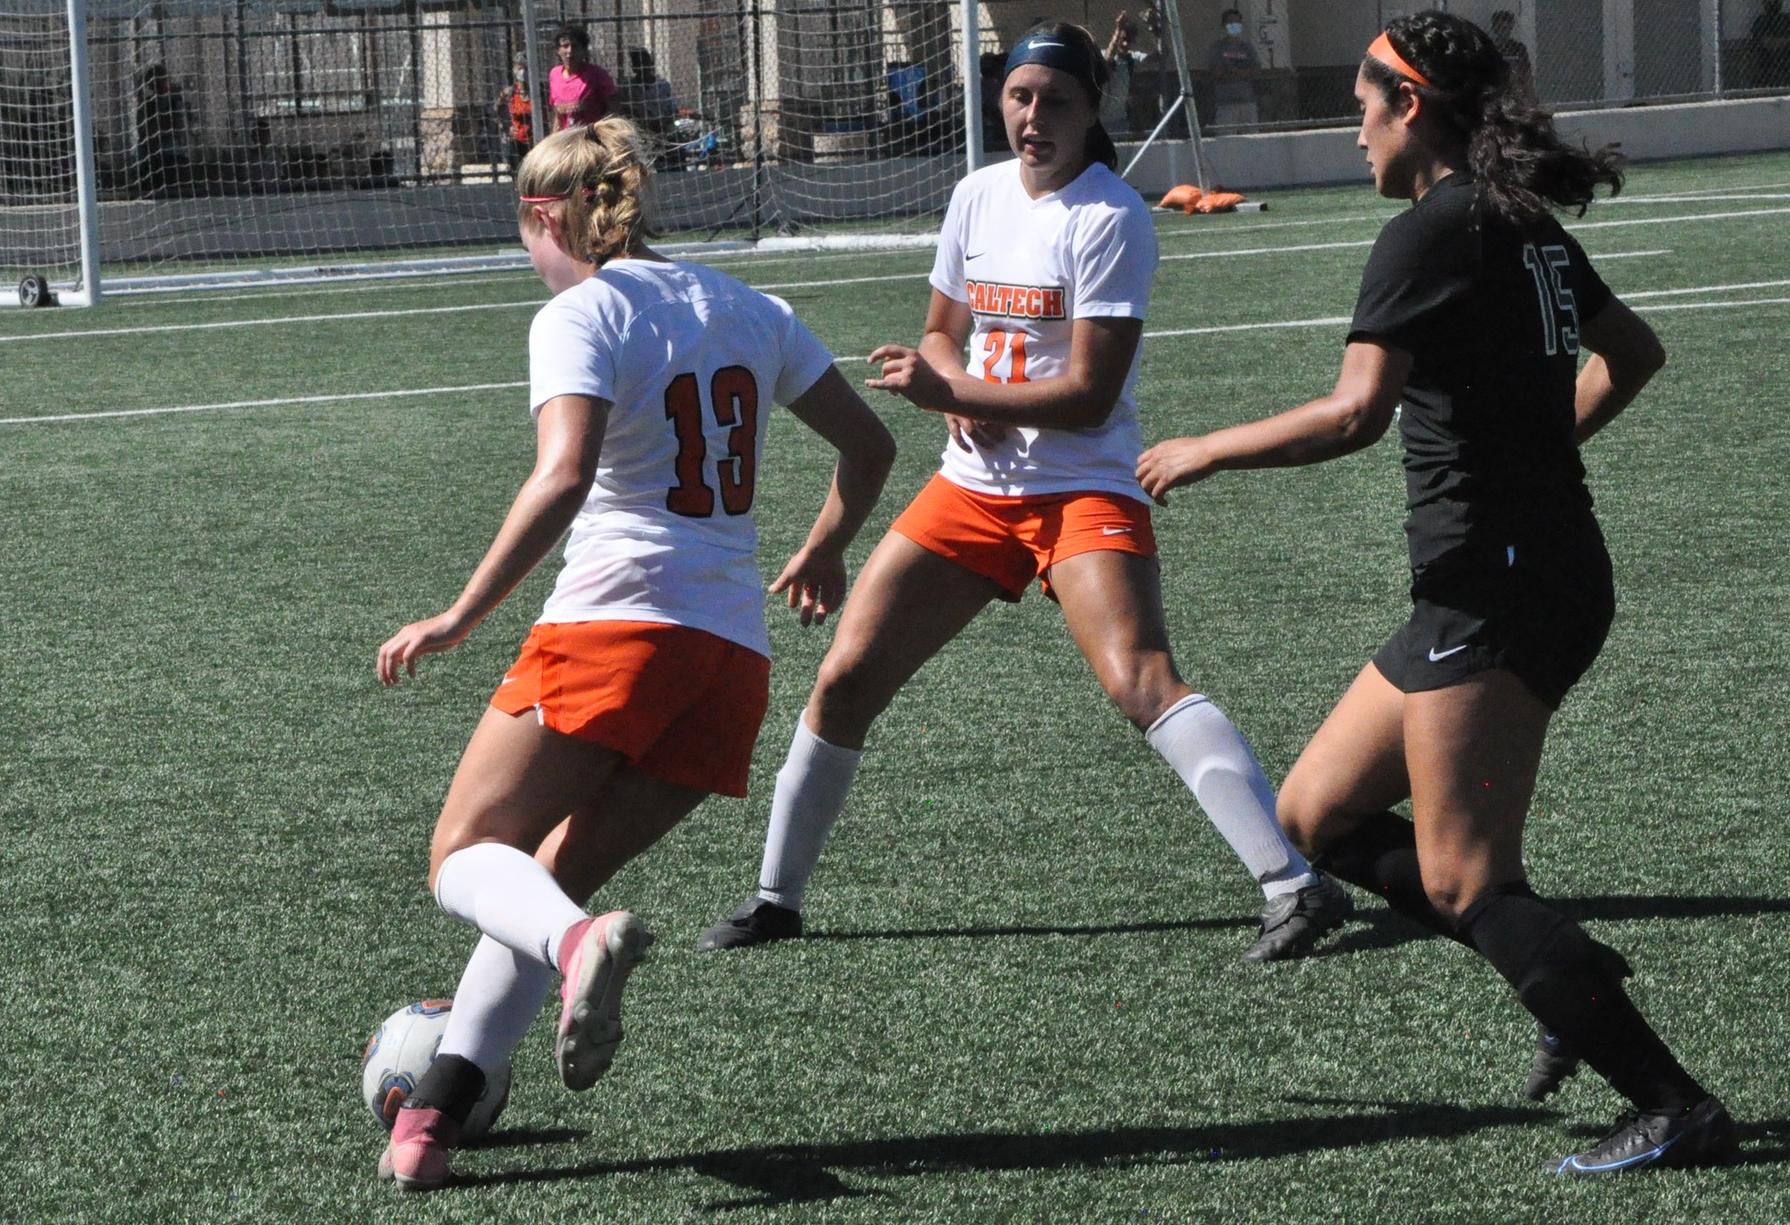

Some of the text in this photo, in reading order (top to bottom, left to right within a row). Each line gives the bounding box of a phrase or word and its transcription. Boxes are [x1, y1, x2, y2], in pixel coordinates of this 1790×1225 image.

[966, 279, 1066, 320] CALTECH
[1523, 242, 1580, 355] 15
[984, 328, 1031, 384] 21
[664, 364, 758, 518] 13
